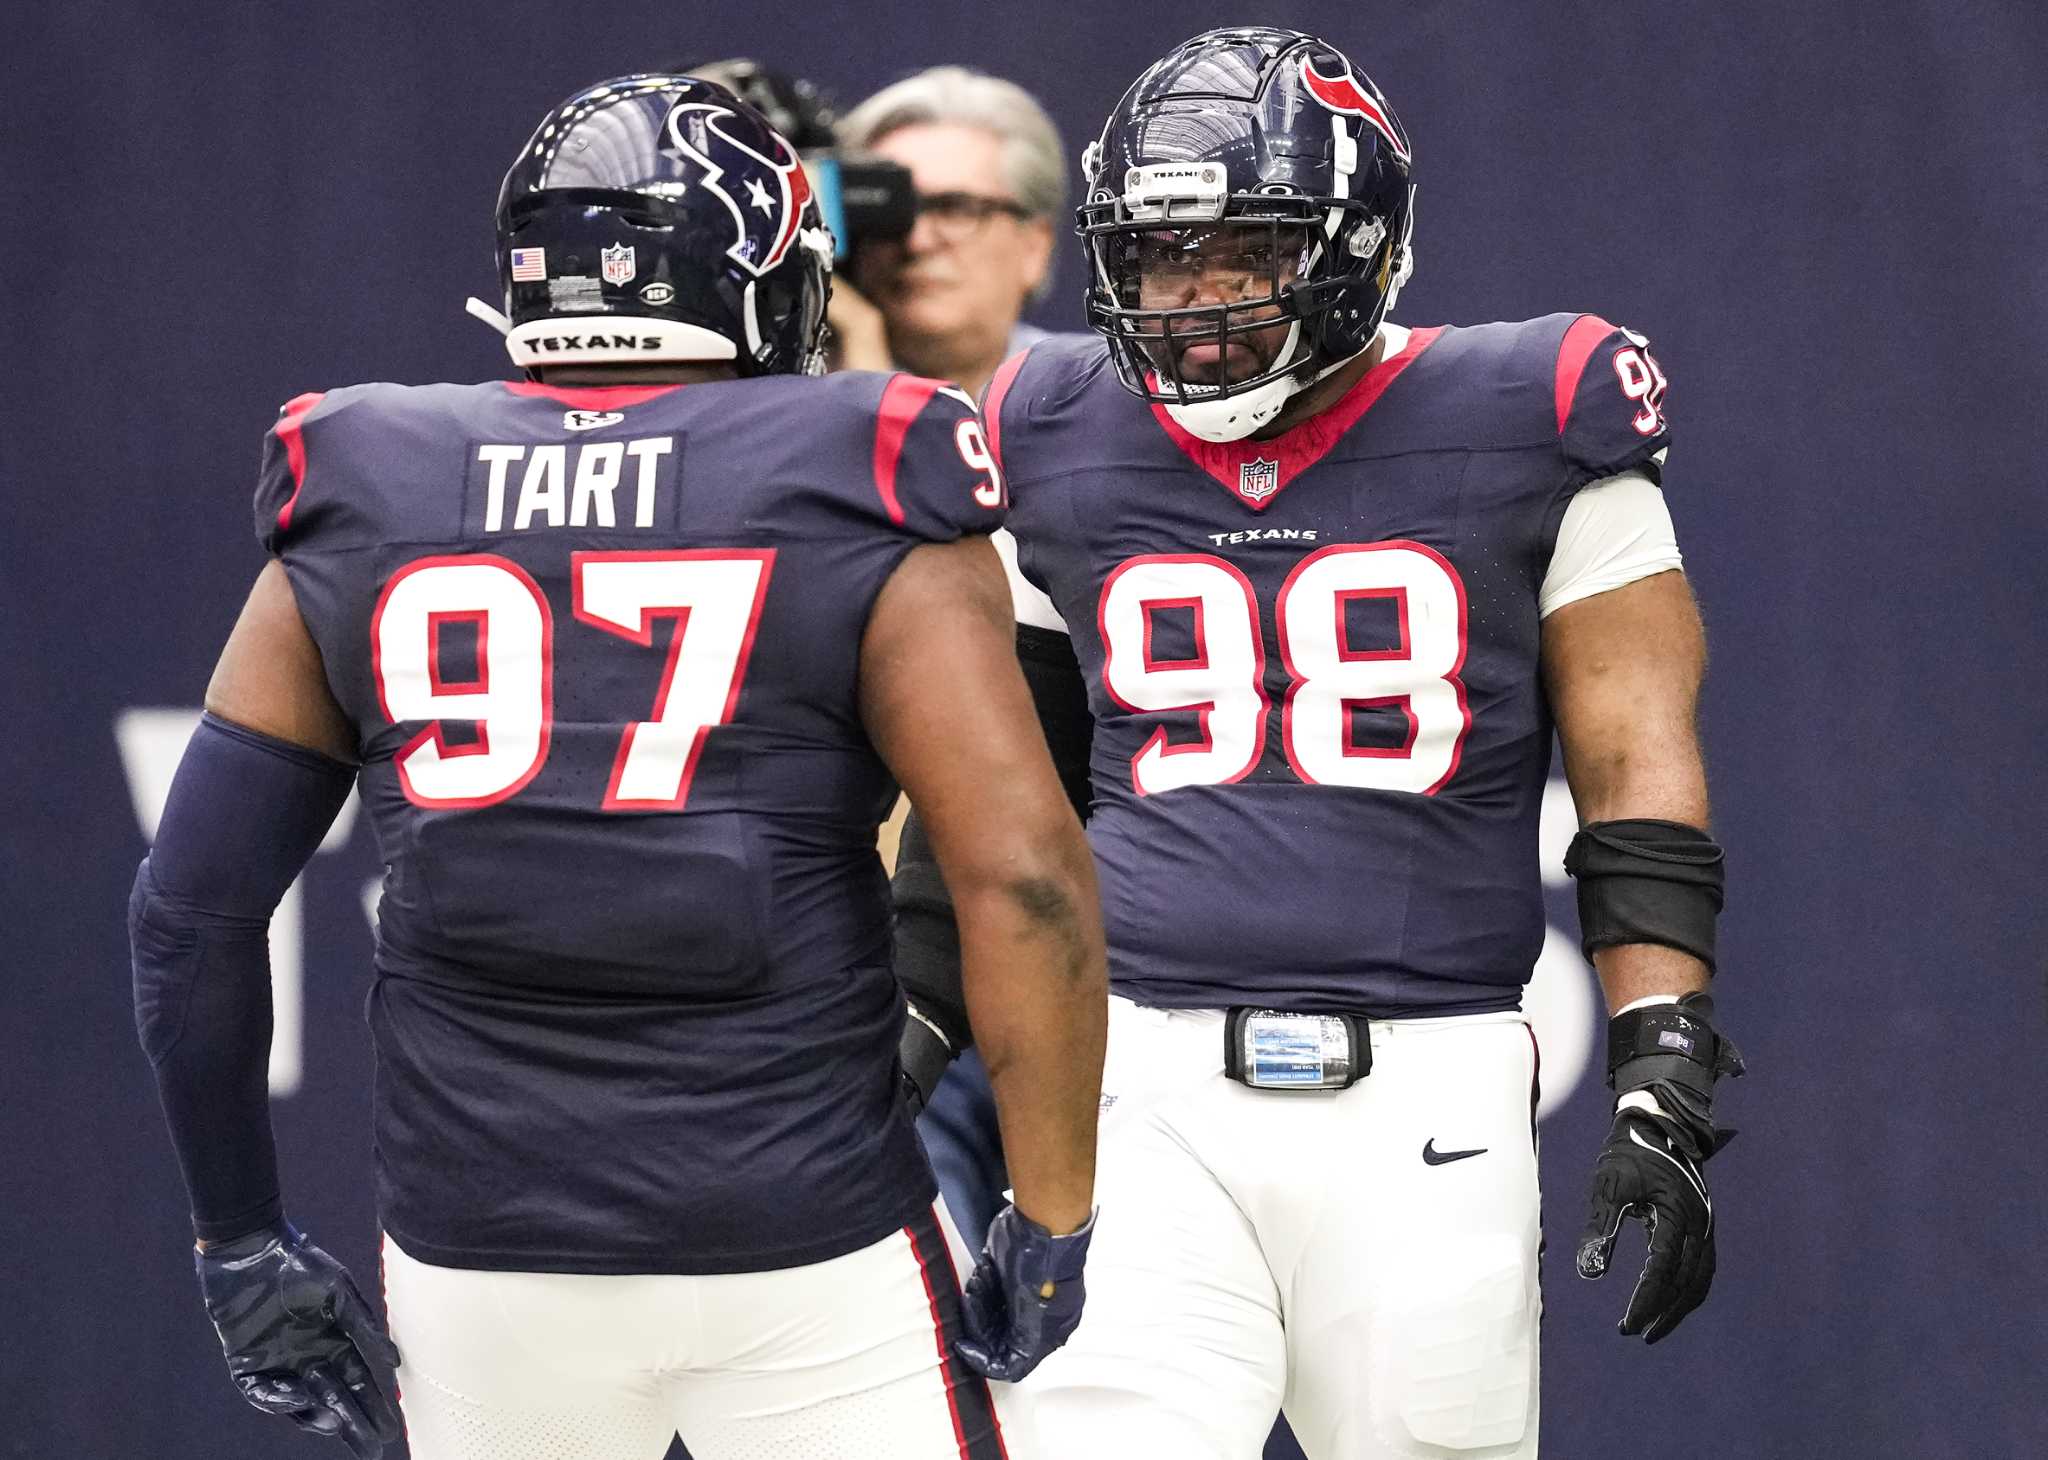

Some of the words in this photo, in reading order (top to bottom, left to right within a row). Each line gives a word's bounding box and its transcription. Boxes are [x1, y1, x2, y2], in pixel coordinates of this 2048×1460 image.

[607, 261, 630, 279] NFL
[523, 336, 662, 354] TEXANS
[478, 437, 672, 532] TART
[1246, 475, 1271, 491] NFL
[1208, 529, 1318, 546] TEXANS
[1097, 540, 1472, 798] 98
[370, 548, 777, 811] 97
